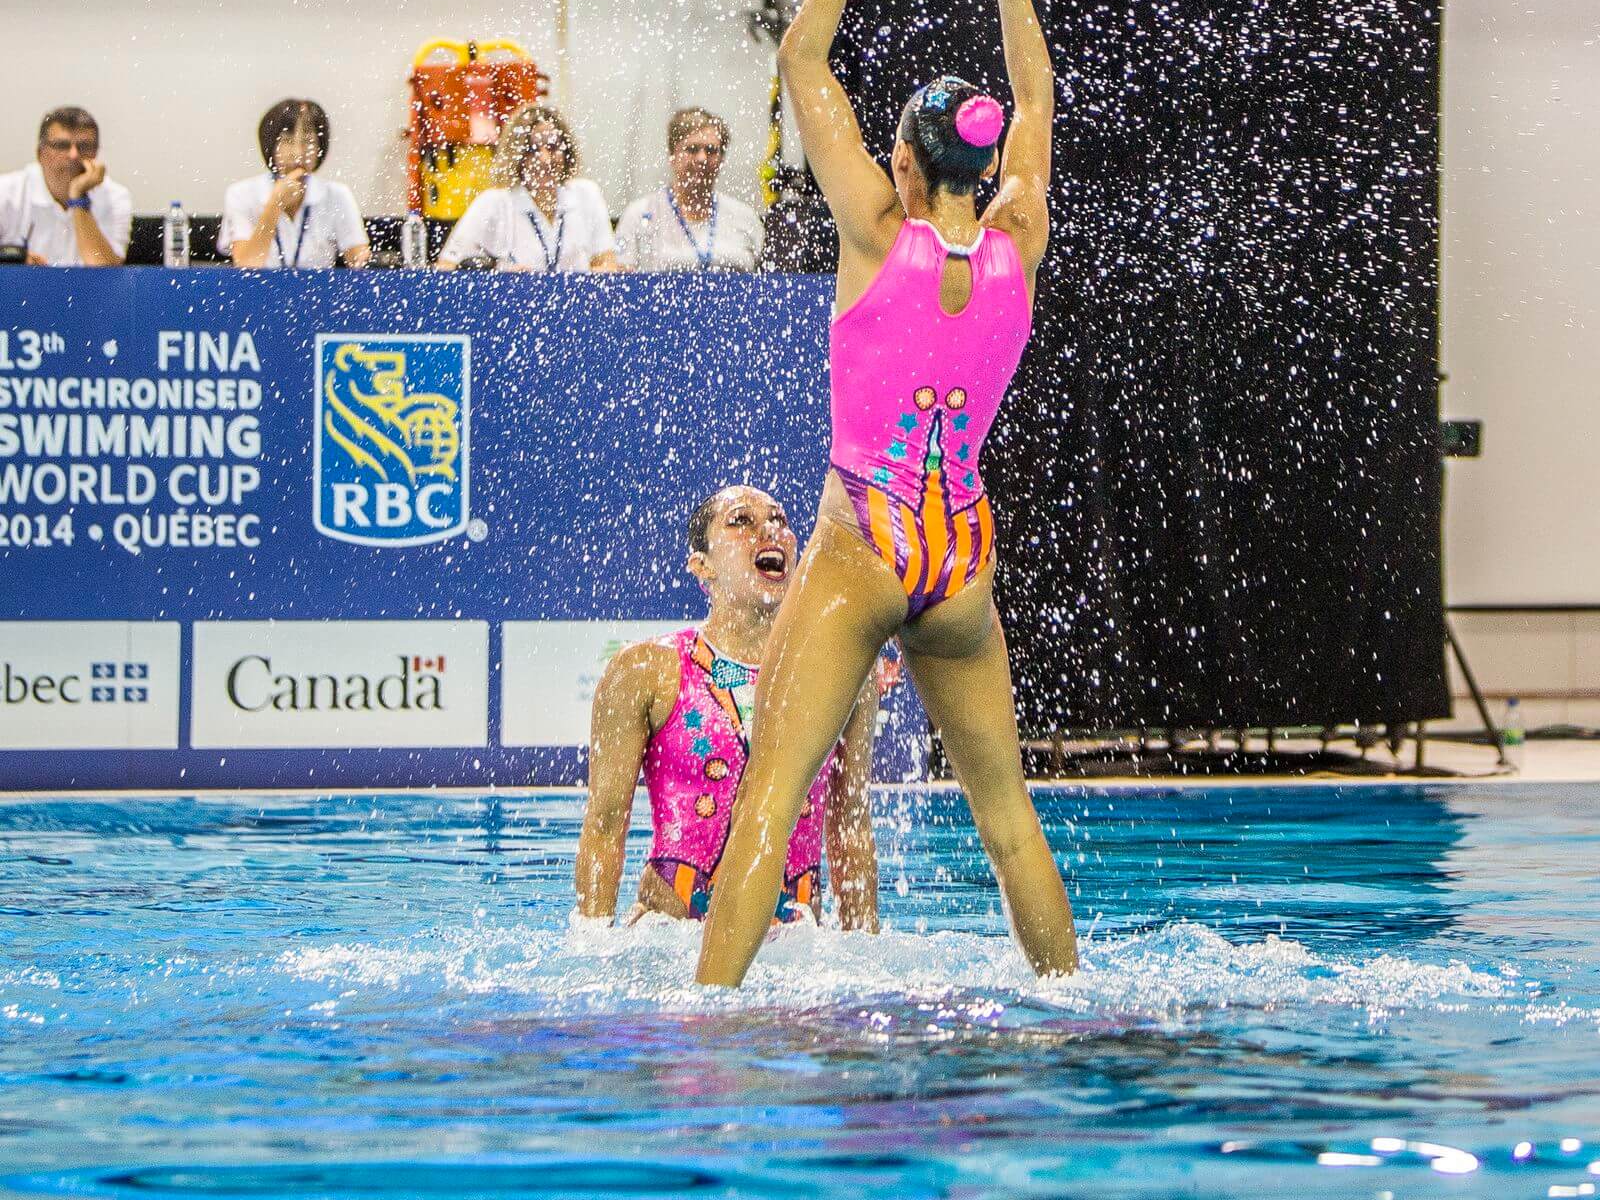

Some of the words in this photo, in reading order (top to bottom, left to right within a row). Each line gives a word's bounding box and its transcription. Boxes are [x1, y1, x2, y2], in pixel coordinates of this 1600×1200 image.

[158, 330, 261, 372] FINA
[0, 377, 262, 410] SYNCHRONISED
[0, 414, 261, 458] SWIMMING
[0, 463, 157, 505] WORLD
[168, 464, 261, 506] CUP
[333, 483, 453, 528] RBC
[113, 507, 261, 555] QUÉBEC
[0, 663, 81, 704] bec
[226, 654, 444, 712] Canada
